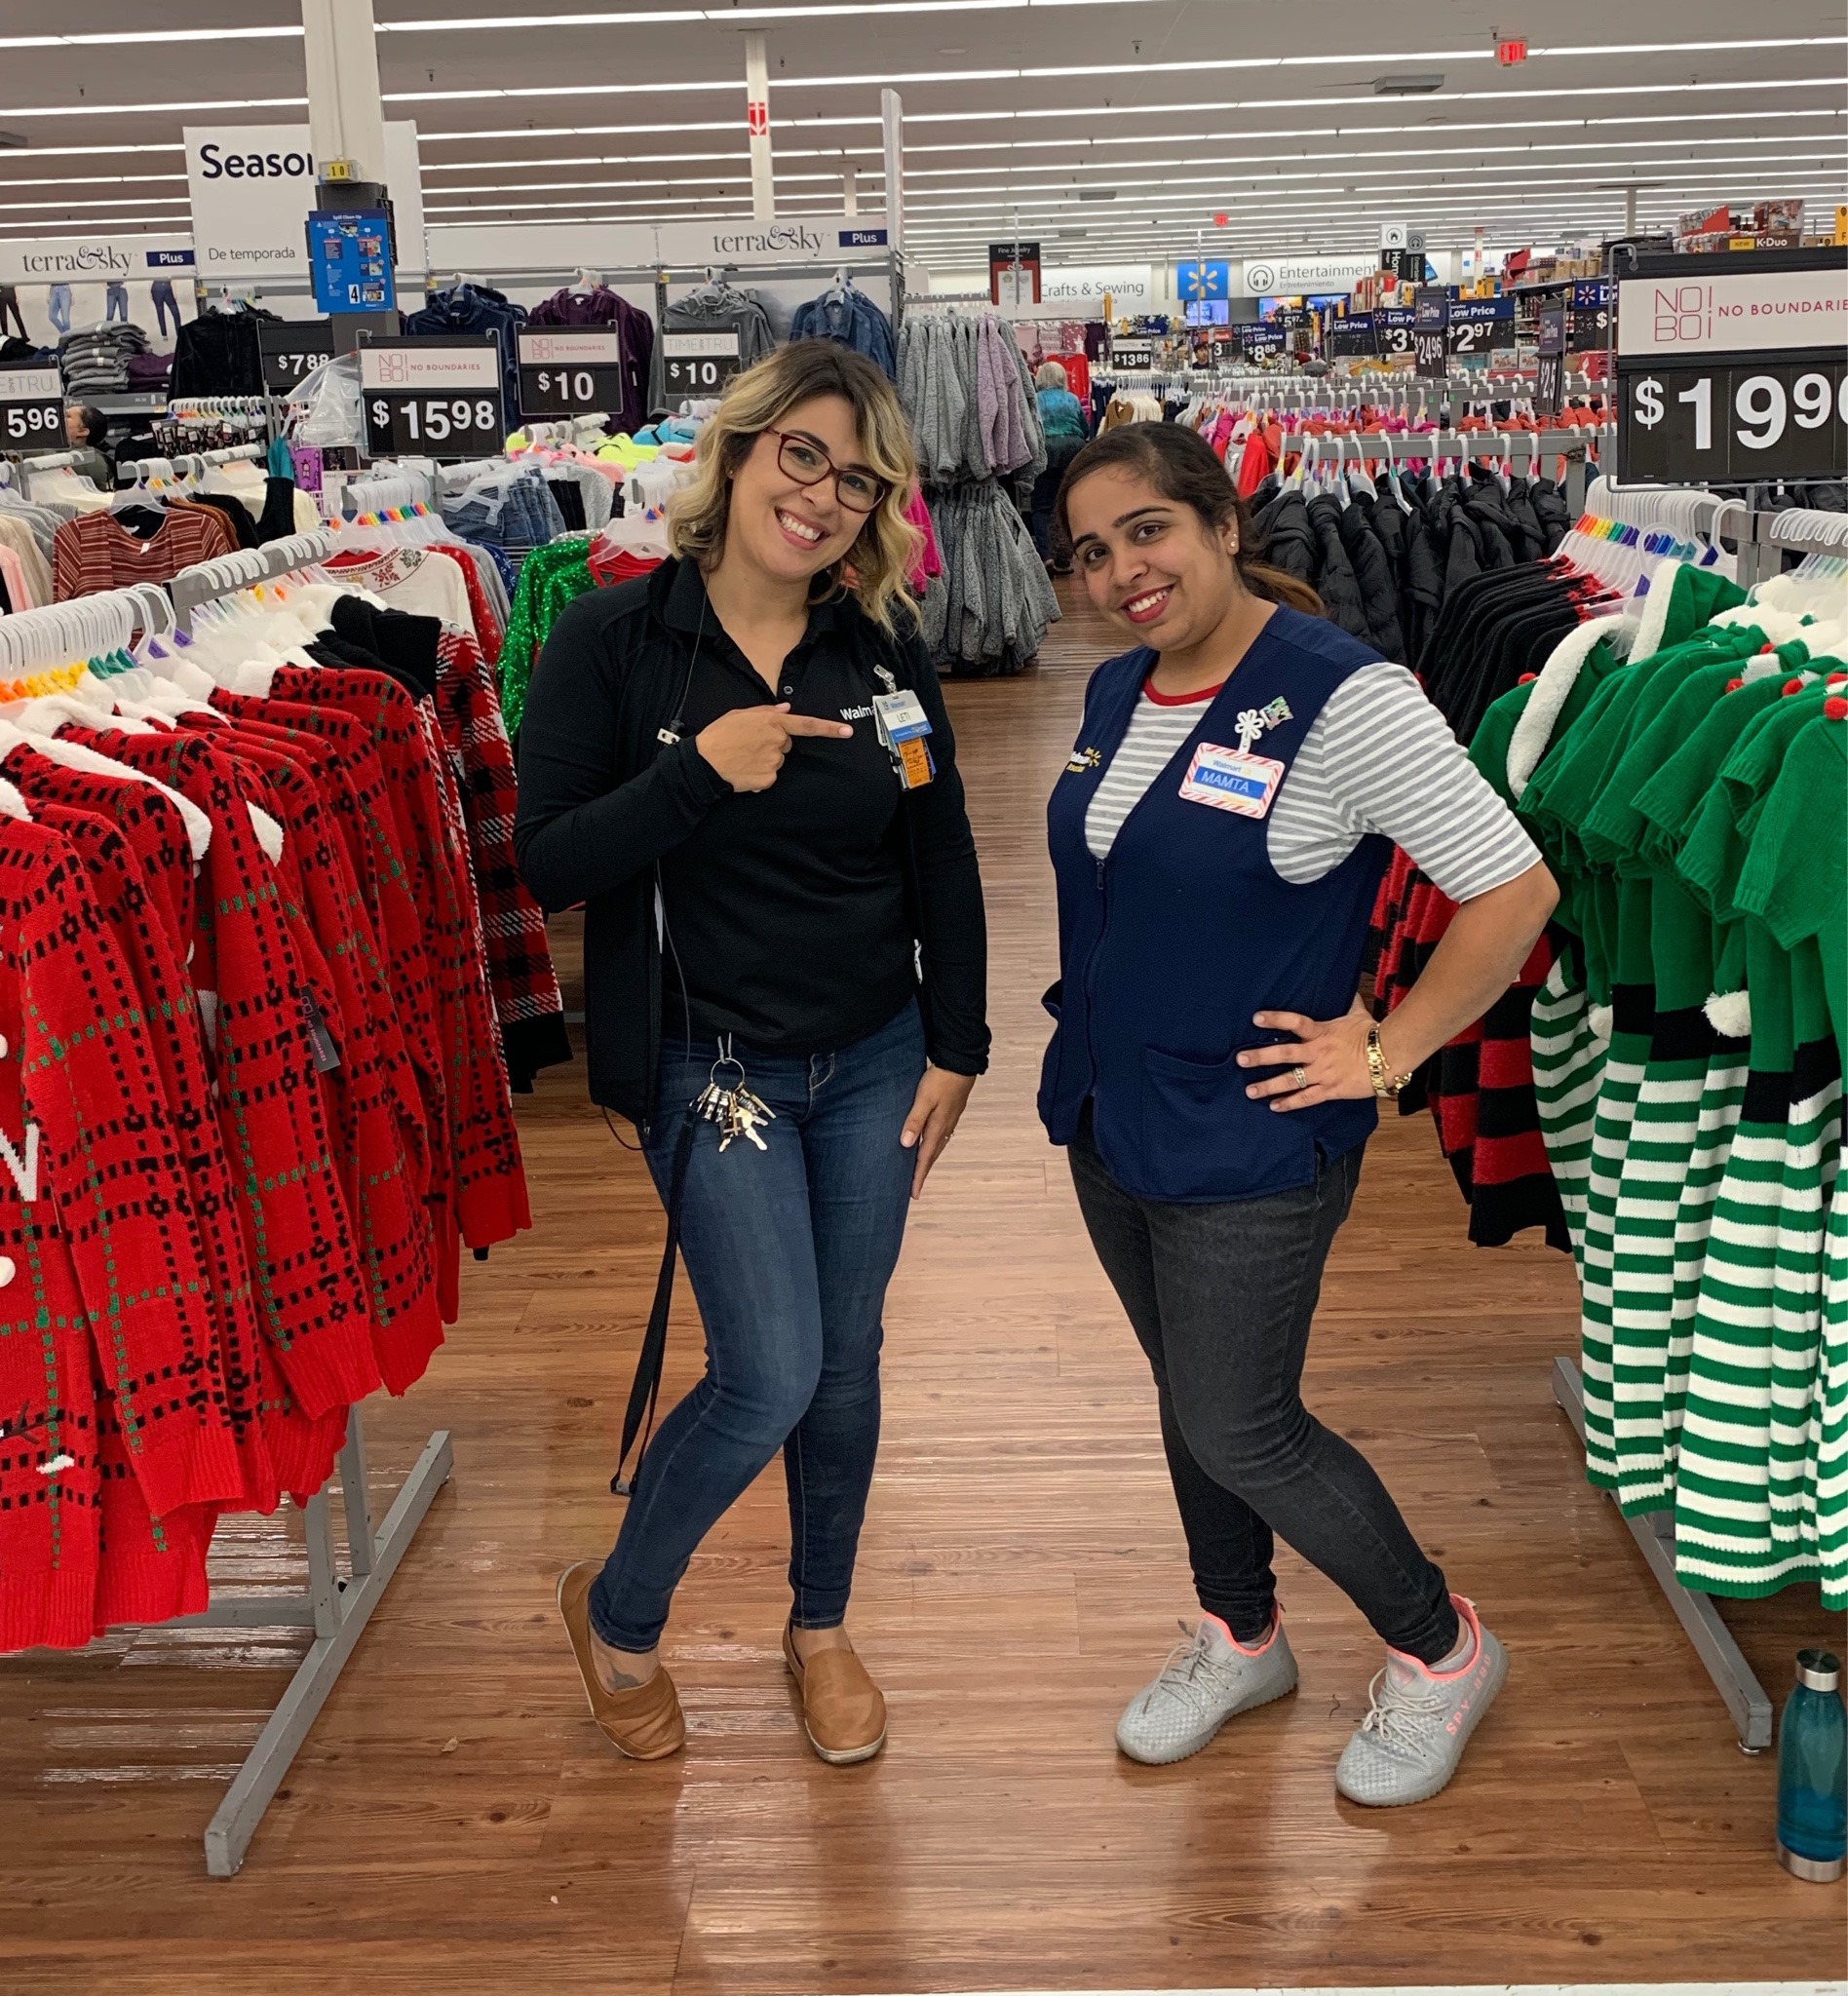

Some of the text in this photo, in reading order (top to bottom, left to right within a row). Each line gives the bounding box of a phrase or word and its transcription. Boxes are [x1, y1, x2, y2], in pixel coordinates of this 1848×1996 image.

[200, 143, 314, 178] Seaso
[712, 225, 877, 257] terra&sky Plus
[22, 246, 183, 277] terra&sky Plus
[209, 247, 295, 262] De temporada
[1280, 264, 1377, 279] Entertainment
[351, 286, 358, 302] 4
[1041, 282, 1078, 297] Crafts
[1081, 282, 1092, 295] &
[1095, 281, 1144, 297] Sewing
[1388, 314, 1405, 323] Low
[1449, 305, 1496, 318] Low Price
[1718, 305, 1744, 317] NO
[1248, 344, 1276, 362] $888
[1413, 335, 1443, 365] $2496
[1114, 353, 1149, 365] $1386
[670, 363, 717, 384] $10
[538, 371, 594, 401] $10
[1201, 771, 1250, 793] MAMTA
